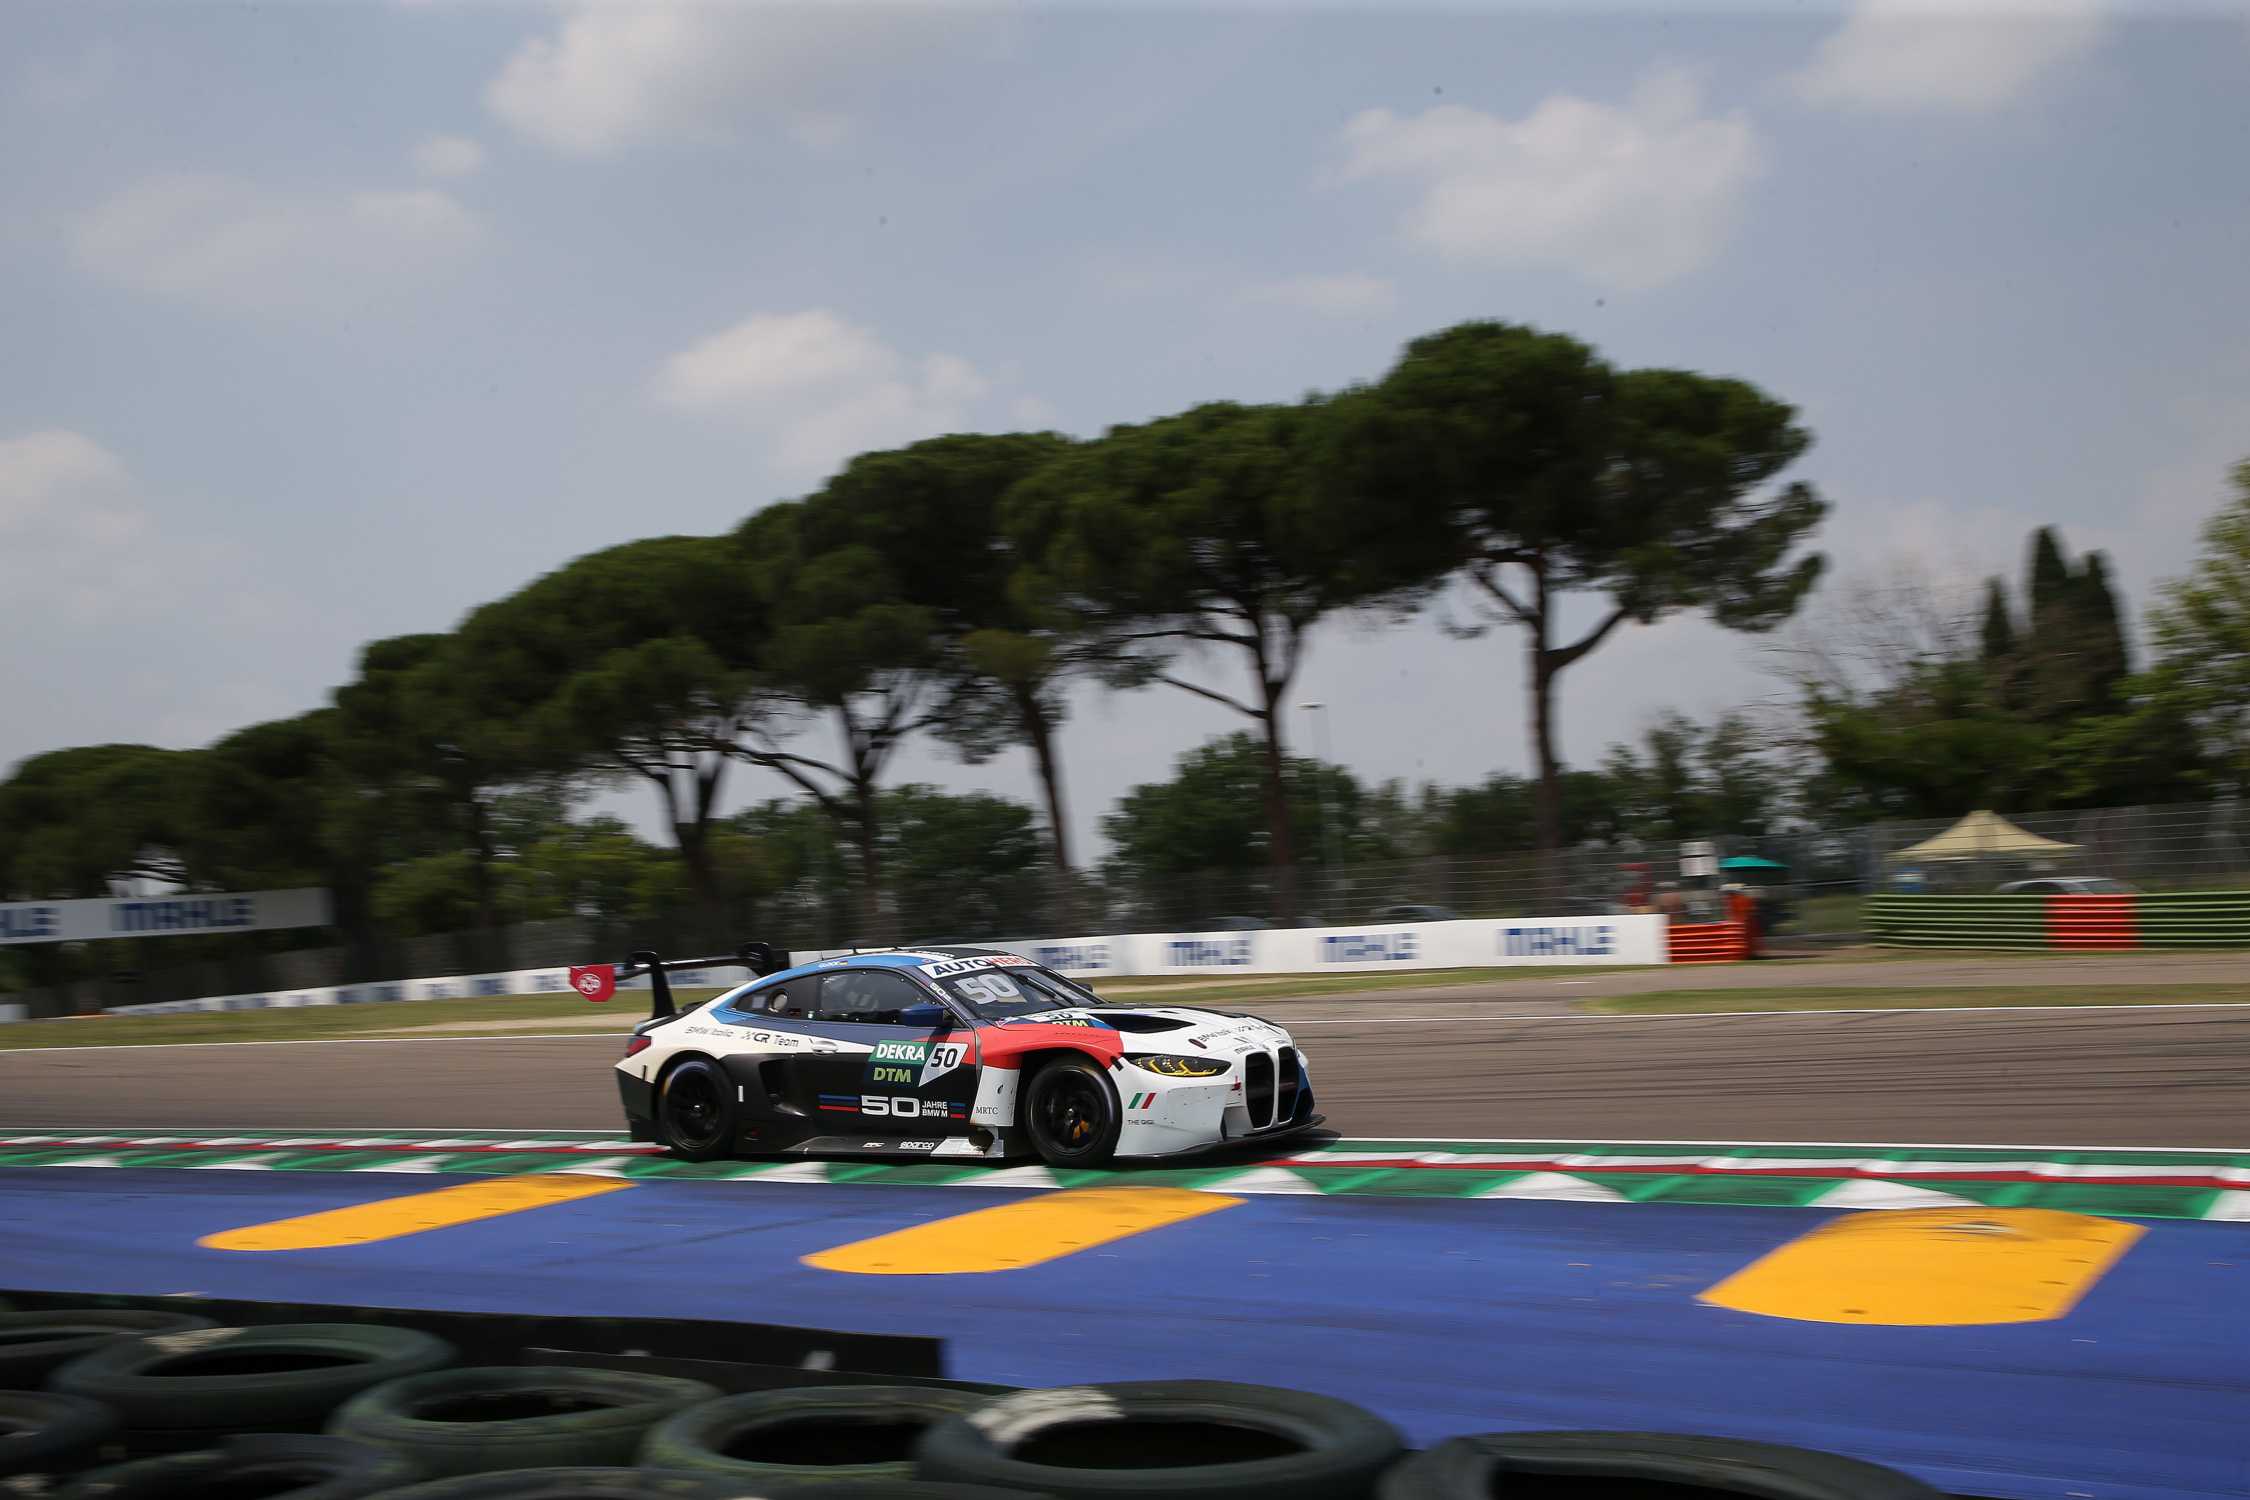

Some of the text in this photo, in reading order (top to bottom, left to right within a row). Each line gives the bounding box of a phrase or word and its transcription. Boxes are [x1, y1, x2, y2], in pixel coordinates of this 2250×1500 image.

[115, 898, 254, 931] MAHLE
[1319, 933, 1417, 962] MAHLE
[1502, 926, 1616, 955] MAHLE
[1164, 940, 1250, 966] MAHLE
[954, 974, 1020, 1004] 50
[774, 1035, 799, 1047] Team
[876, 1044, 925, 1061] DEKRA
[931, 1048, 958, 1067] 50
[873, 1067, 911, 1082] DTM
[861, 1095, 920, 1117] 50
[922, 1101, 947, 1109] JAHRE
[922, 1108, 948, 1118] BMW M
[976, 1106, 998, 1114] MRTC
[898, 1141, 934, 1150] sparco
